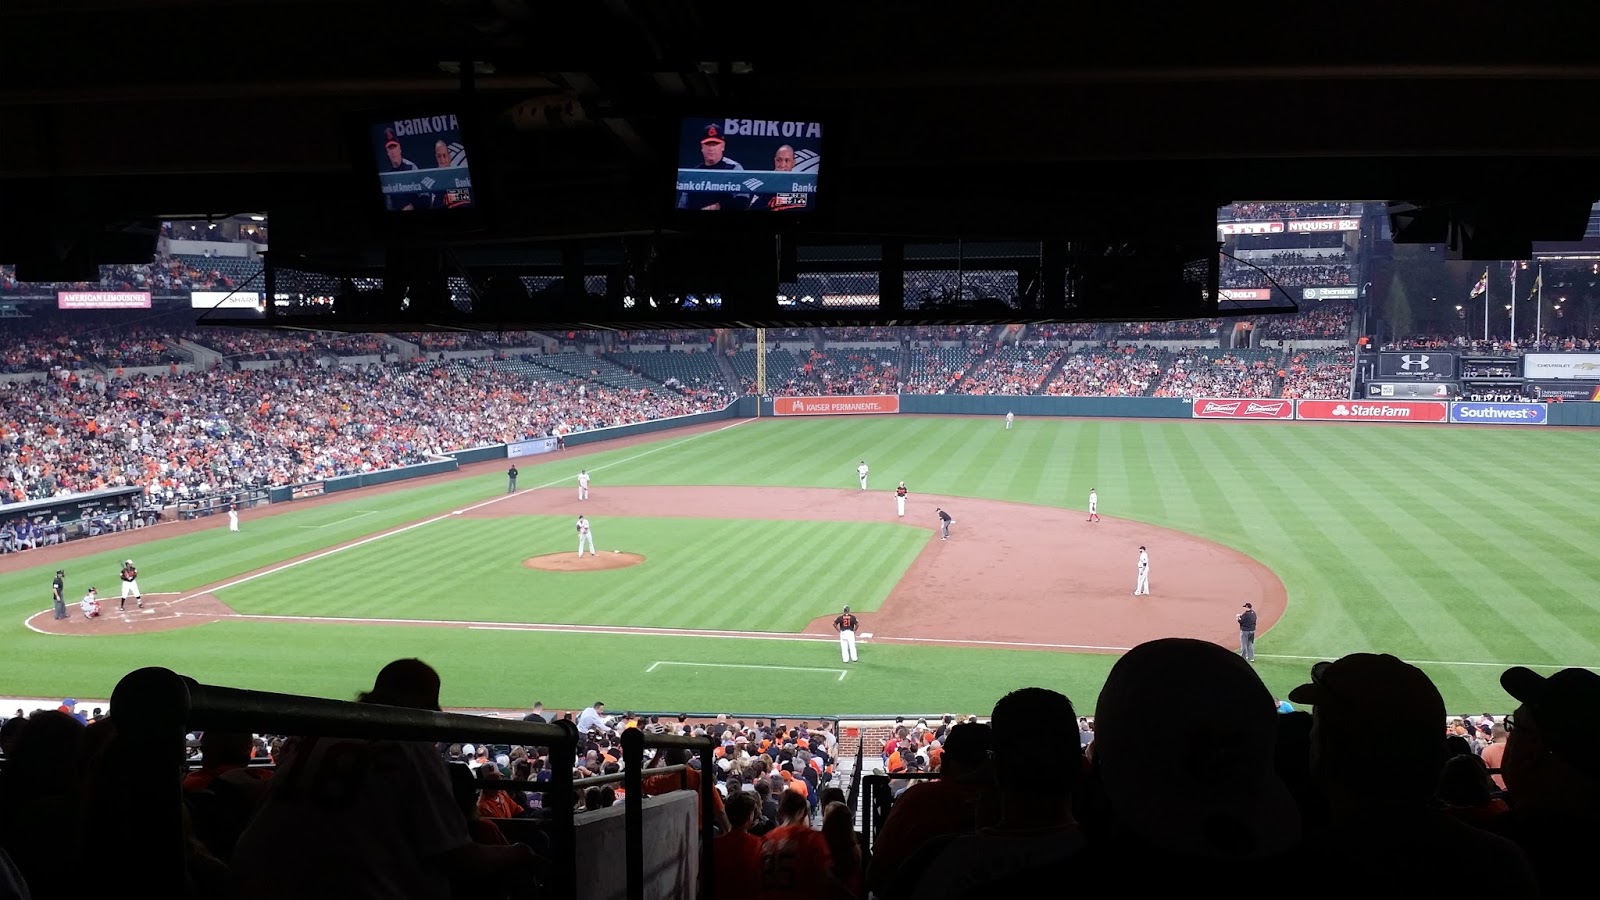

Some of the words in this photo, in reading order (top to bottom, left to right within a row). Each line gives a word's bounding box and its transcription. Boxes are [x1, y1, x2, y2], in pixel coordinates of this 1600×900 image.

[394, 117, 431, 137] Bank
[724, 118, 780, 136] Bank
[806, 122, 821, 138] A
[381, 183, 393, 193] ank
[399, 182, 422, 192] America
[695, 181, 705, 191] of
[705, 181, 741, 191] America
[792, 183, 813, 193] Bank
[1289, 221, 1333, 232] NYQUIST
[64, 294, 102, 302] AMERICAN
[103, 294, 146, 302] LIMOUSINES
[806, 403, 830, 412] KAISER
[1460, 406, 1528, 419] Southwest
[842, 618, 851, 627] 21
